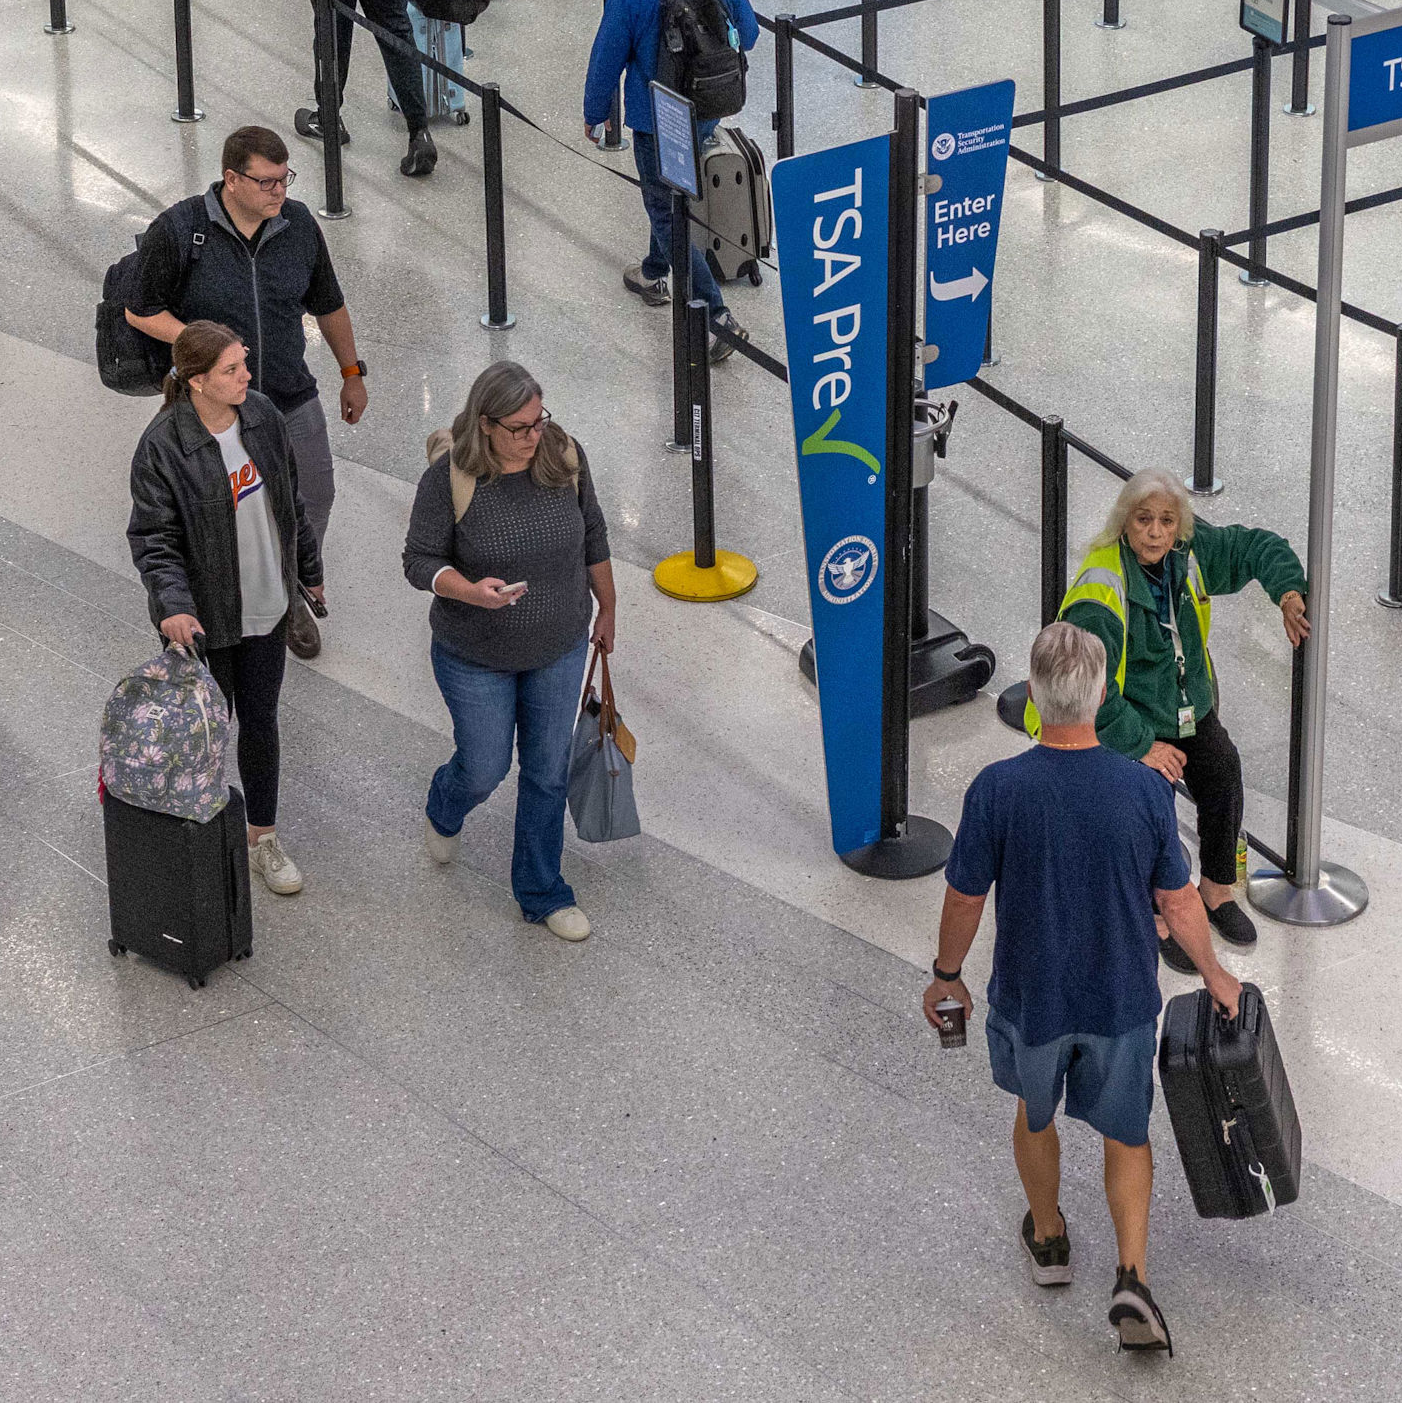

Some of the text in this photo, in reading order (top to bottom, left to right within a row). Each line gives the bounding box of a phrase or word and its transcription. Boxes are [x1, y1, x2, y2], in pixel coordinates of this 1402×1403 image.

[957, 123, 1005, 140] Transportation
[957, 135, 985, 148] Security
[957, 137, 1006, 156] Administration
[934, 193, 996, 224] Enter
[937, 220, 991, 249] Here
[812, 167, 863, 411] TSA Pre
